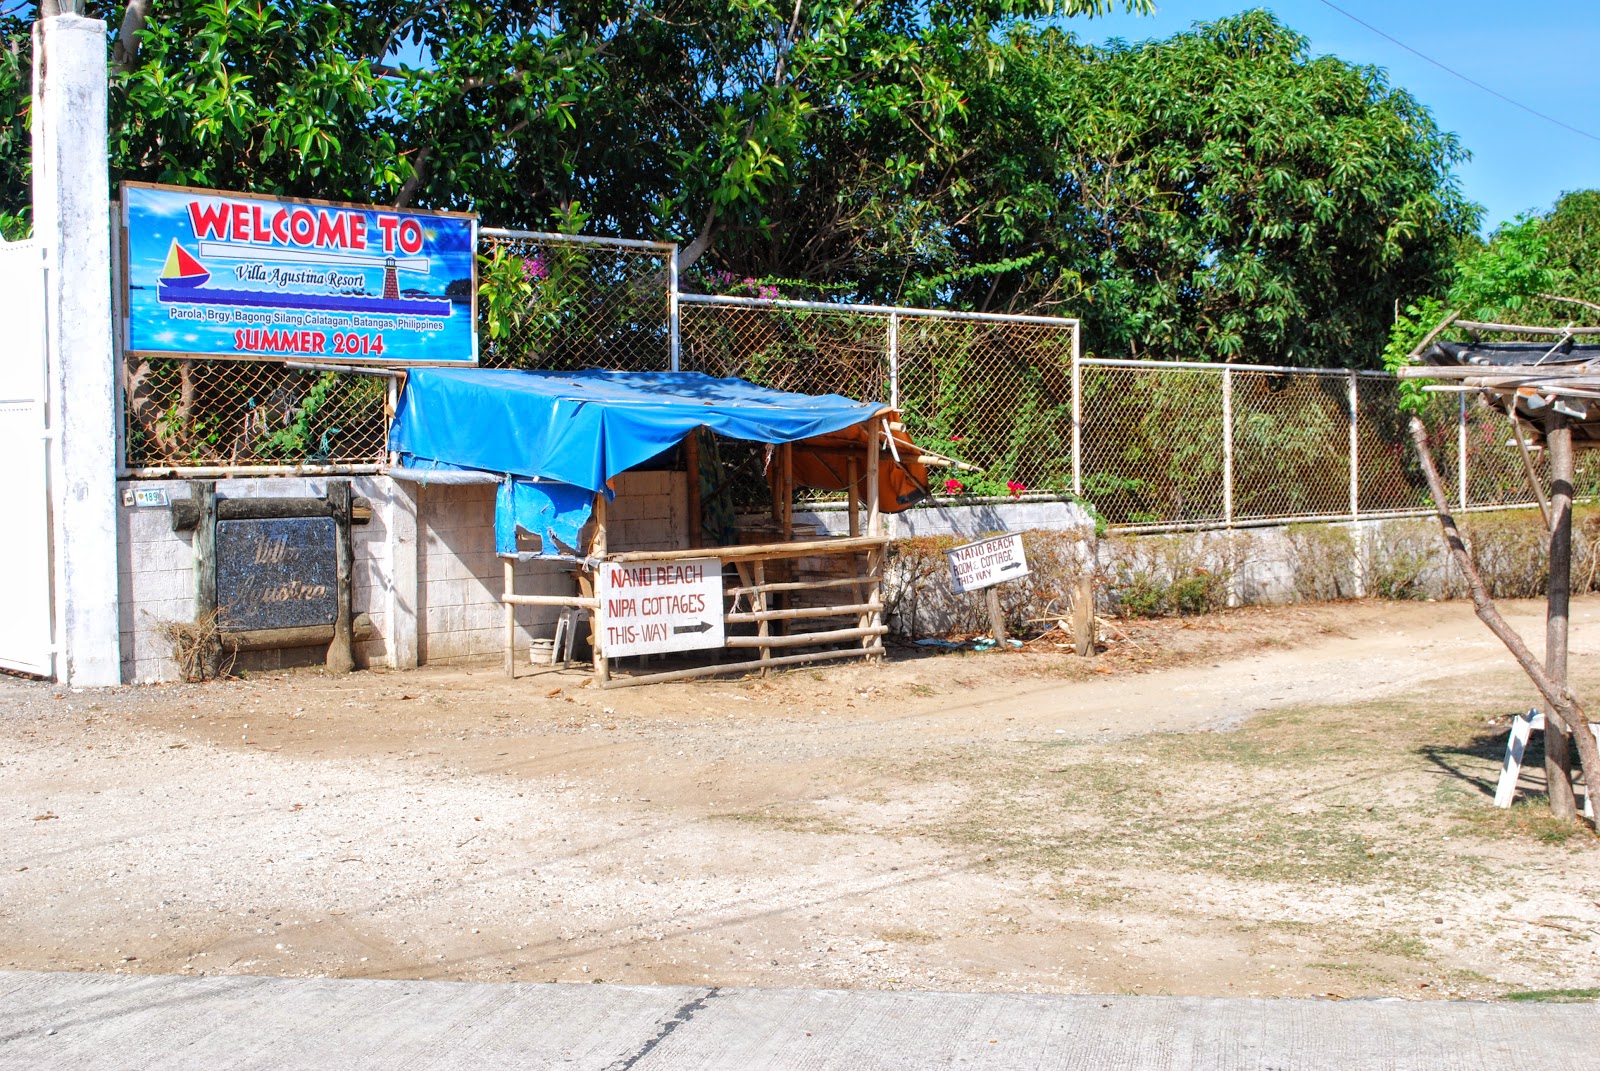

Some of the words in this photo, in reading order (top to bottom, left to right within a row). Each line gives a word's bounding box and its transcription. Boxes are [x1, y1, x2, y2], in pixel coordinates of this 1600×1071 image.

[188, 201, 368, 250] WELCOME
[379, 217, 422, 254] TO
[236, 264, 267, 281] Villa
[268, 268, 325, 287] Agustina
[328, 272, 364, 288] Resort
[170, 308, 205, 320] Parola,
[208, 310, 232, 322] Brgy.
[235, 311, 272, 324] Bagong
[274, 313, 303, 326] Silang
[305, 314, 351, 328] Calatagan,
[353, 317, 396, 329] Batangas,
[398, 319, 443, 332] Philippines
[234, 328, 325, 353] SUMMER
[333, 332, 384, 355] 2014
[986, 537, 1014, 553] BEACH
[953, 562, 973, 576] ROOM
[980, 550, 1013, 568] COTTAGE
[611, 567, 652, 588] NANO
[656, 565, 703, 586] BEACH
[958, 575, 973, 586] THIS
[975, 569, 991, 581] WAY
[608, 599, 637, 618] NIPA
[641, 594, 705, 616] COTTAGES
